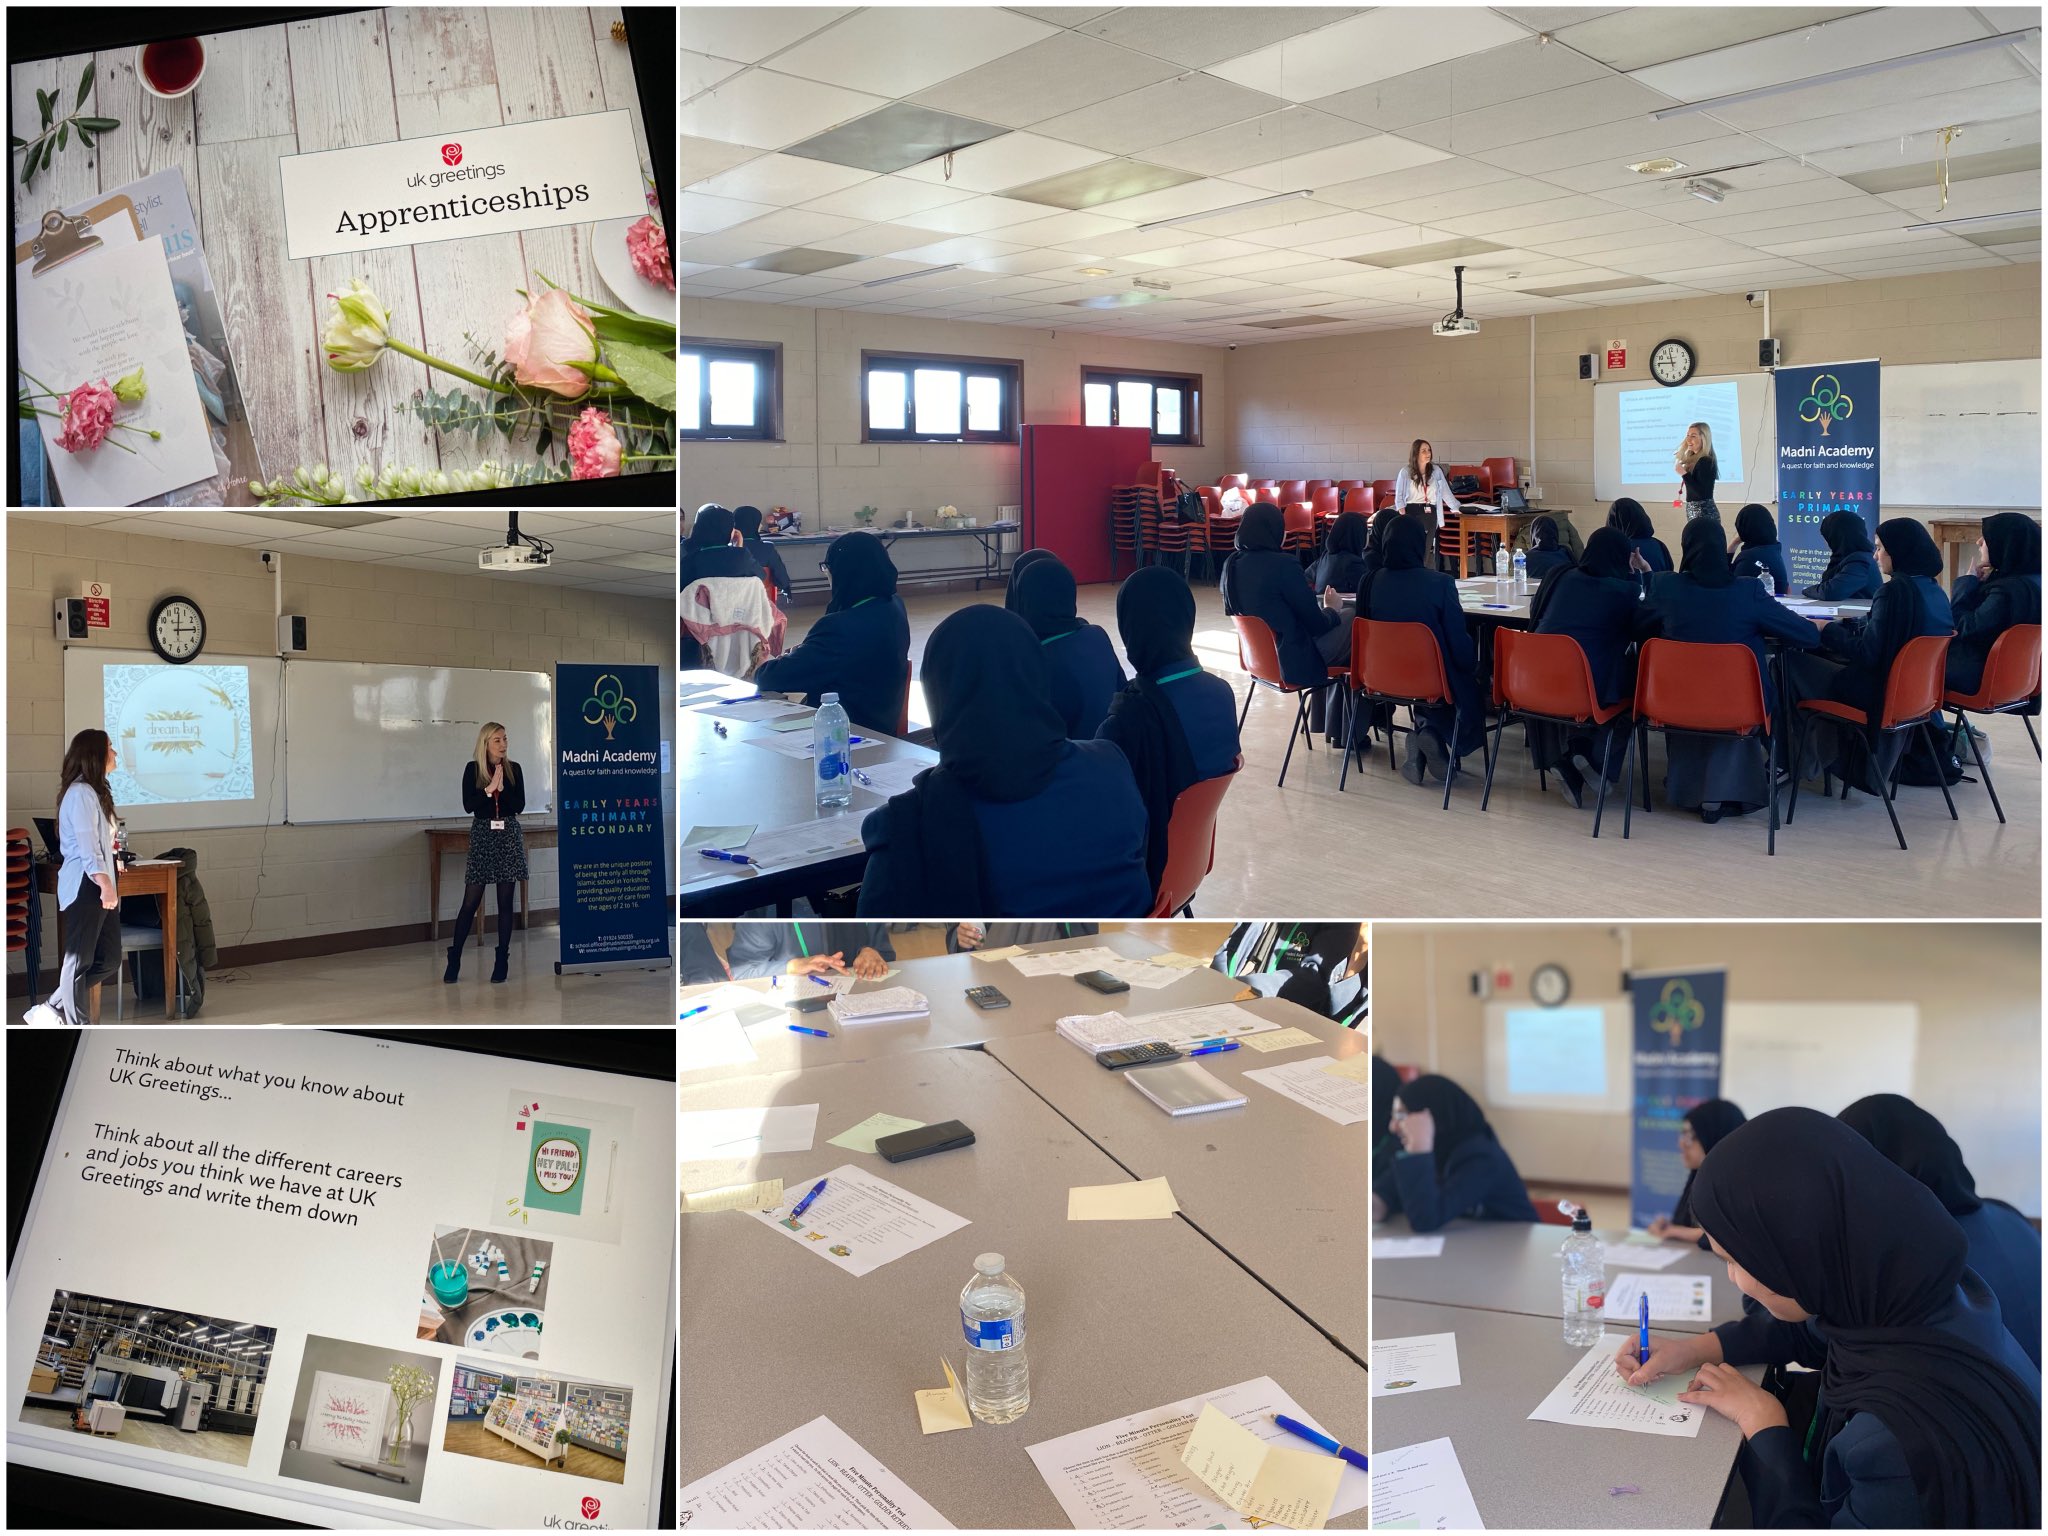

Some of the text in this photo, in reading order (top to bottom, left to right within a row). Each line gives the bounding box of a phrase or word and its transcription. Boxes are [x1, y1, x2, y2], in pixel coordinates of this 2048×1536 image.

[407, 162, 505, 188] uk greetings
[135, 194, 163, 215] stylist
[335, 183, 590, 235] Apprenticeships
[1781, 445, 1874, 459] Madni Academy
[1840, 462, 1874, 470] knowledge
[1782, 491, 1873, 500] EARLY YEARS
[1797, 503, 1859, 513] PRIMARY
[1793, 571, 1816, 579] providing
[146, 722, 180, 735] dream
[562, 750, 657, 764] Madni Academy
[569, 769, 586, 777] quest
[564, 798, 657, 809] EARLY YEARS
[581, 811, 646, 822] PRIMARY
[571, 823, 652, 835] SECONDARY
[630, 860, 652, 868] position
[577, 887, 603, 896] providing
[604, 886, 623, 895] quality
[588, 896, 616, 904] continuity
[116, 1048, 405, 1106] Think about what you know about
[109, 1068, 232, 1101] UK Greetings...
[94, 1123, 403, 1189] Think about all the different careers
[542, 1147, 577, 1158] HI FRIEND!
[537, 1158, 578, 1172] HEY PAL!!
[86, 1147, 377, 1207] and jobs you think we have at UK
[559, 1172, 573, 1180] YOU!
[81, 1166, 358, 1227] Greetings and write them down
[1115, 1435, 1138, 1446] BEAVER
[1166, 1419, 1189, 1430] GOLDEN
[1128, 1426, 1148, 1436] Minute
[1148, 1415, 1182, 1431] Personality
[827, 1457, 839, 1468] LION
[839, 1467, 857, 1484] BEAVER
[857, 1483, 873, 1498] OTTER
[873, 1497, 893, 1516] GOLDEN
[849, 1466, 860, 1476] Five
[857, 1473, 873, 1488] Minute
[872, 1486, 896, 1509] Personality
[894, 1506, 906, 1517] Test
[544, 1514, 561, 1529] uk
